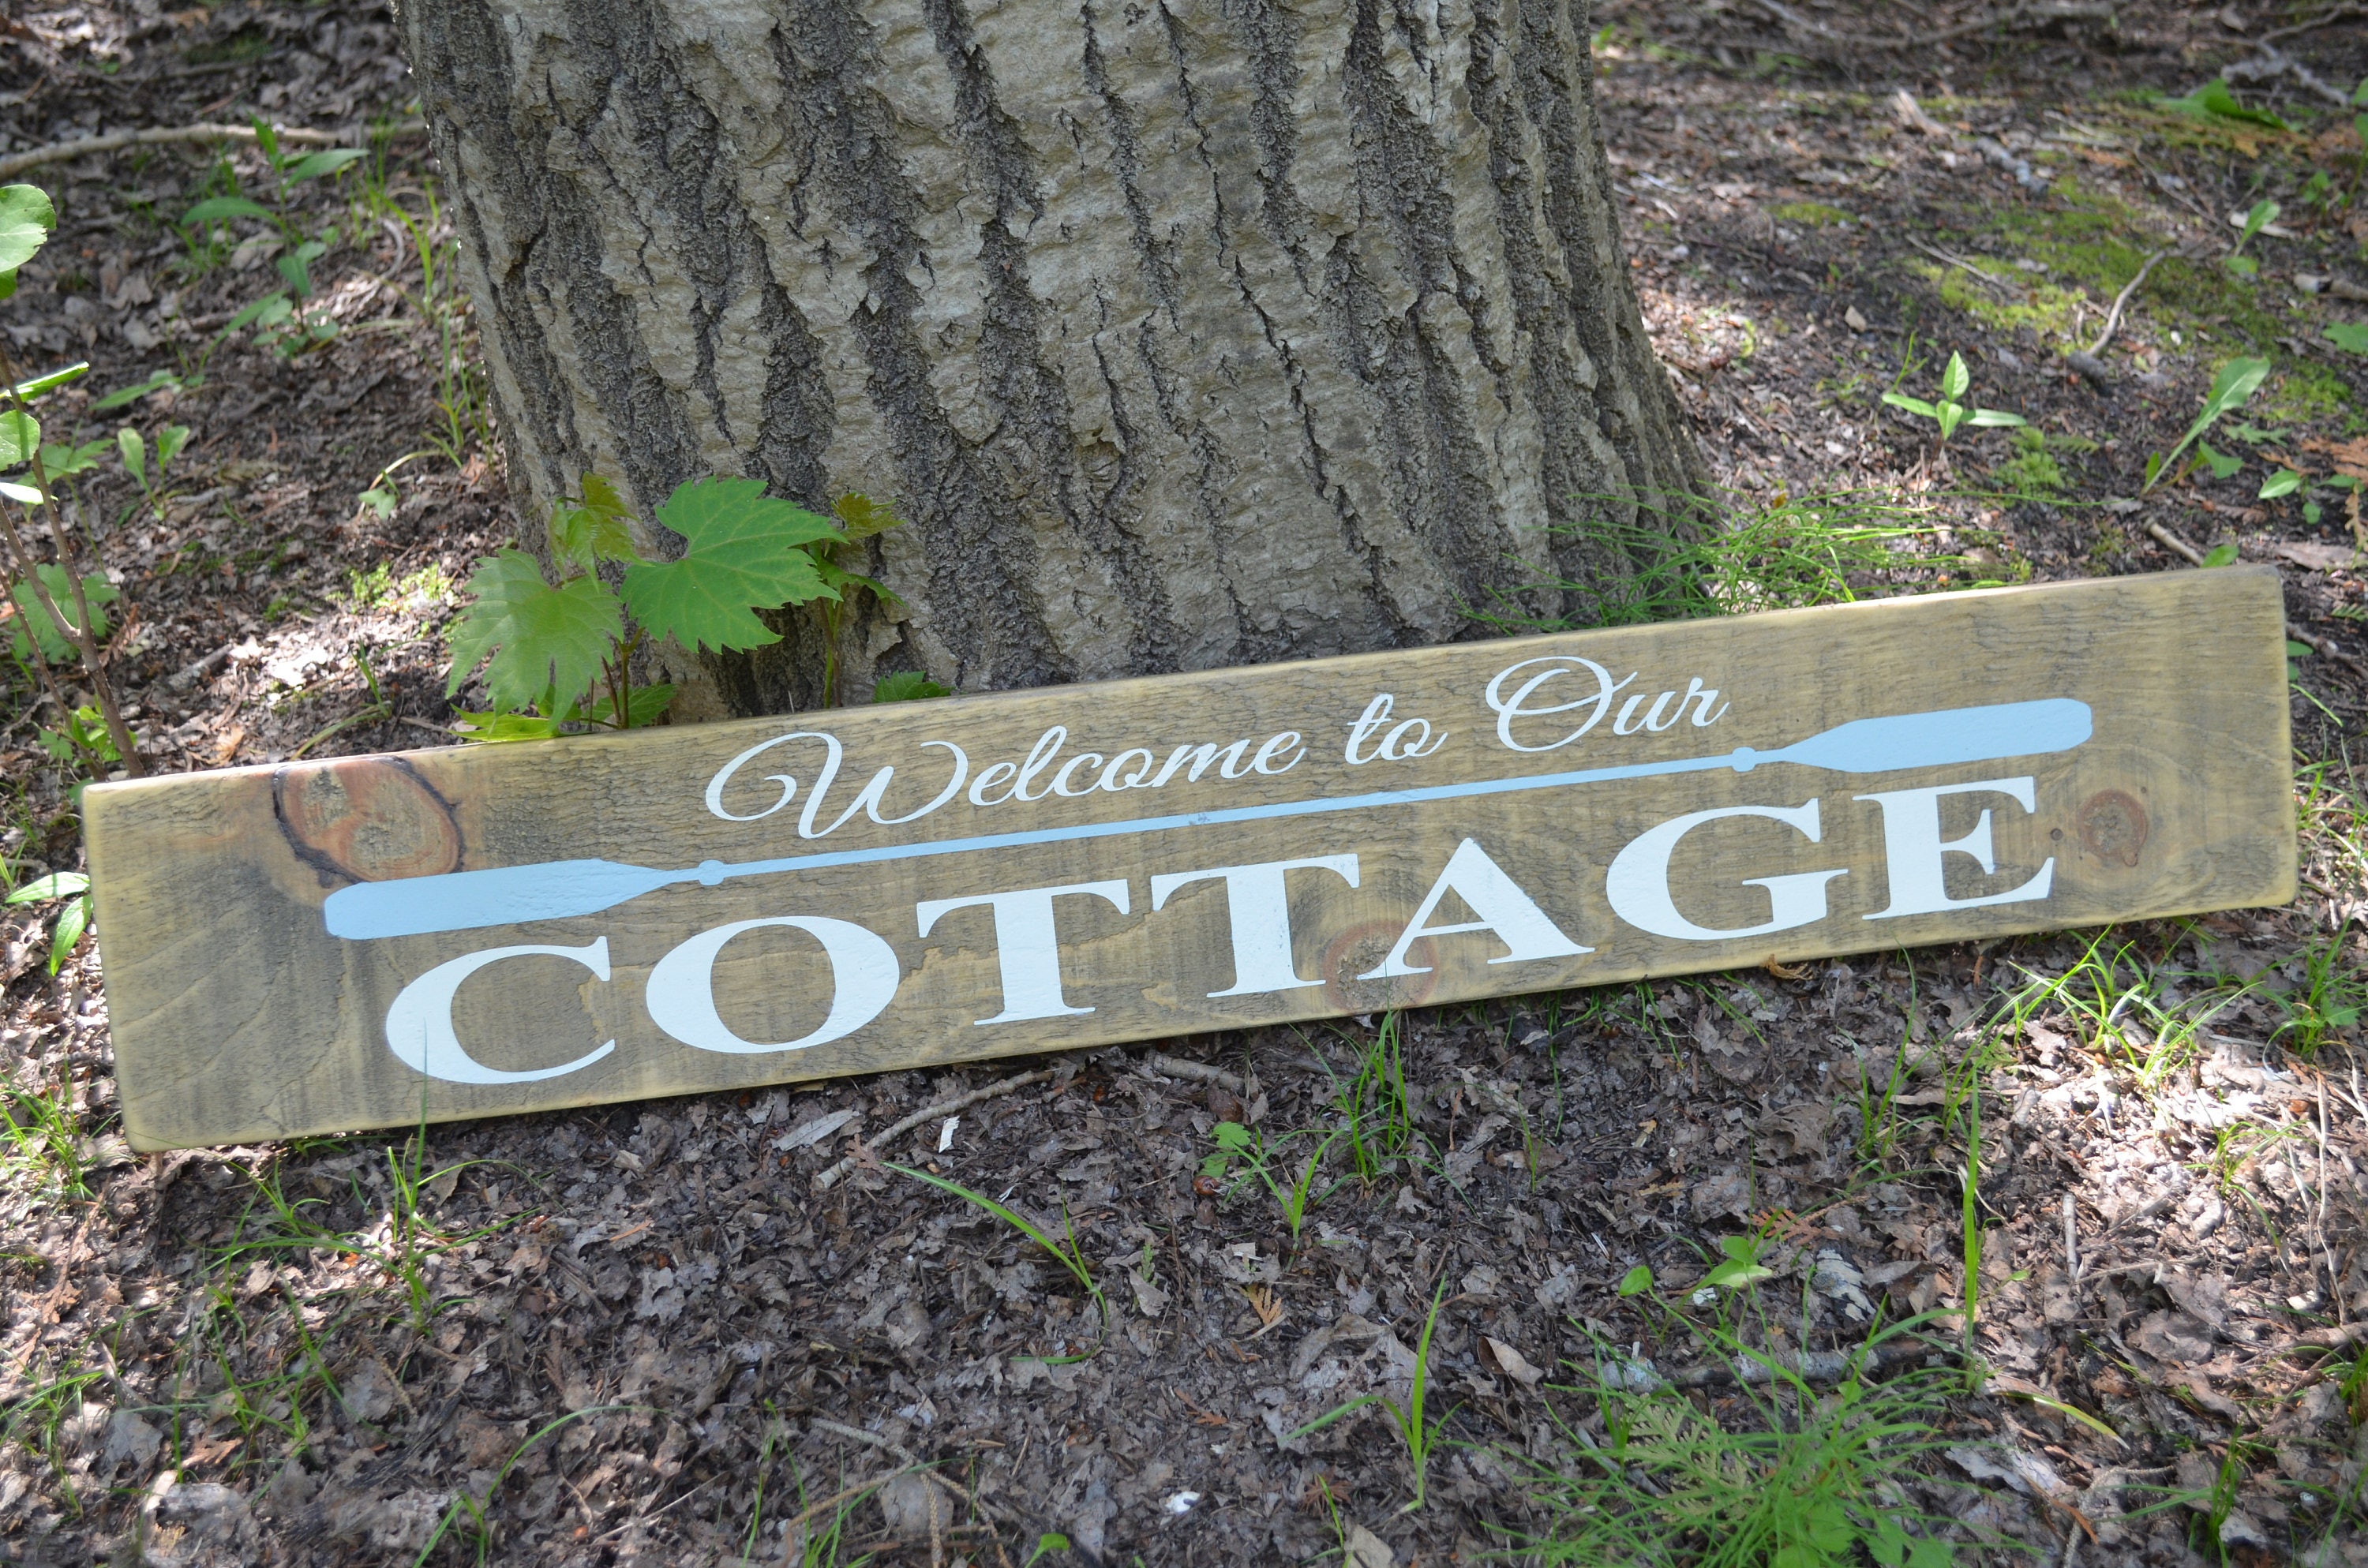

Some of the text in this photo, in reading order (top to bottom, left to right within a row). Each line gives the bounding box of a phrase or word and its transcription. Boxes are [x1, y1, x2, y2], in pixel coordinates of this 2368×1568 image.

[705, 656, 1730, 839] Welcome to Our
[385, 776, 2055, 1084] COTTAGE
